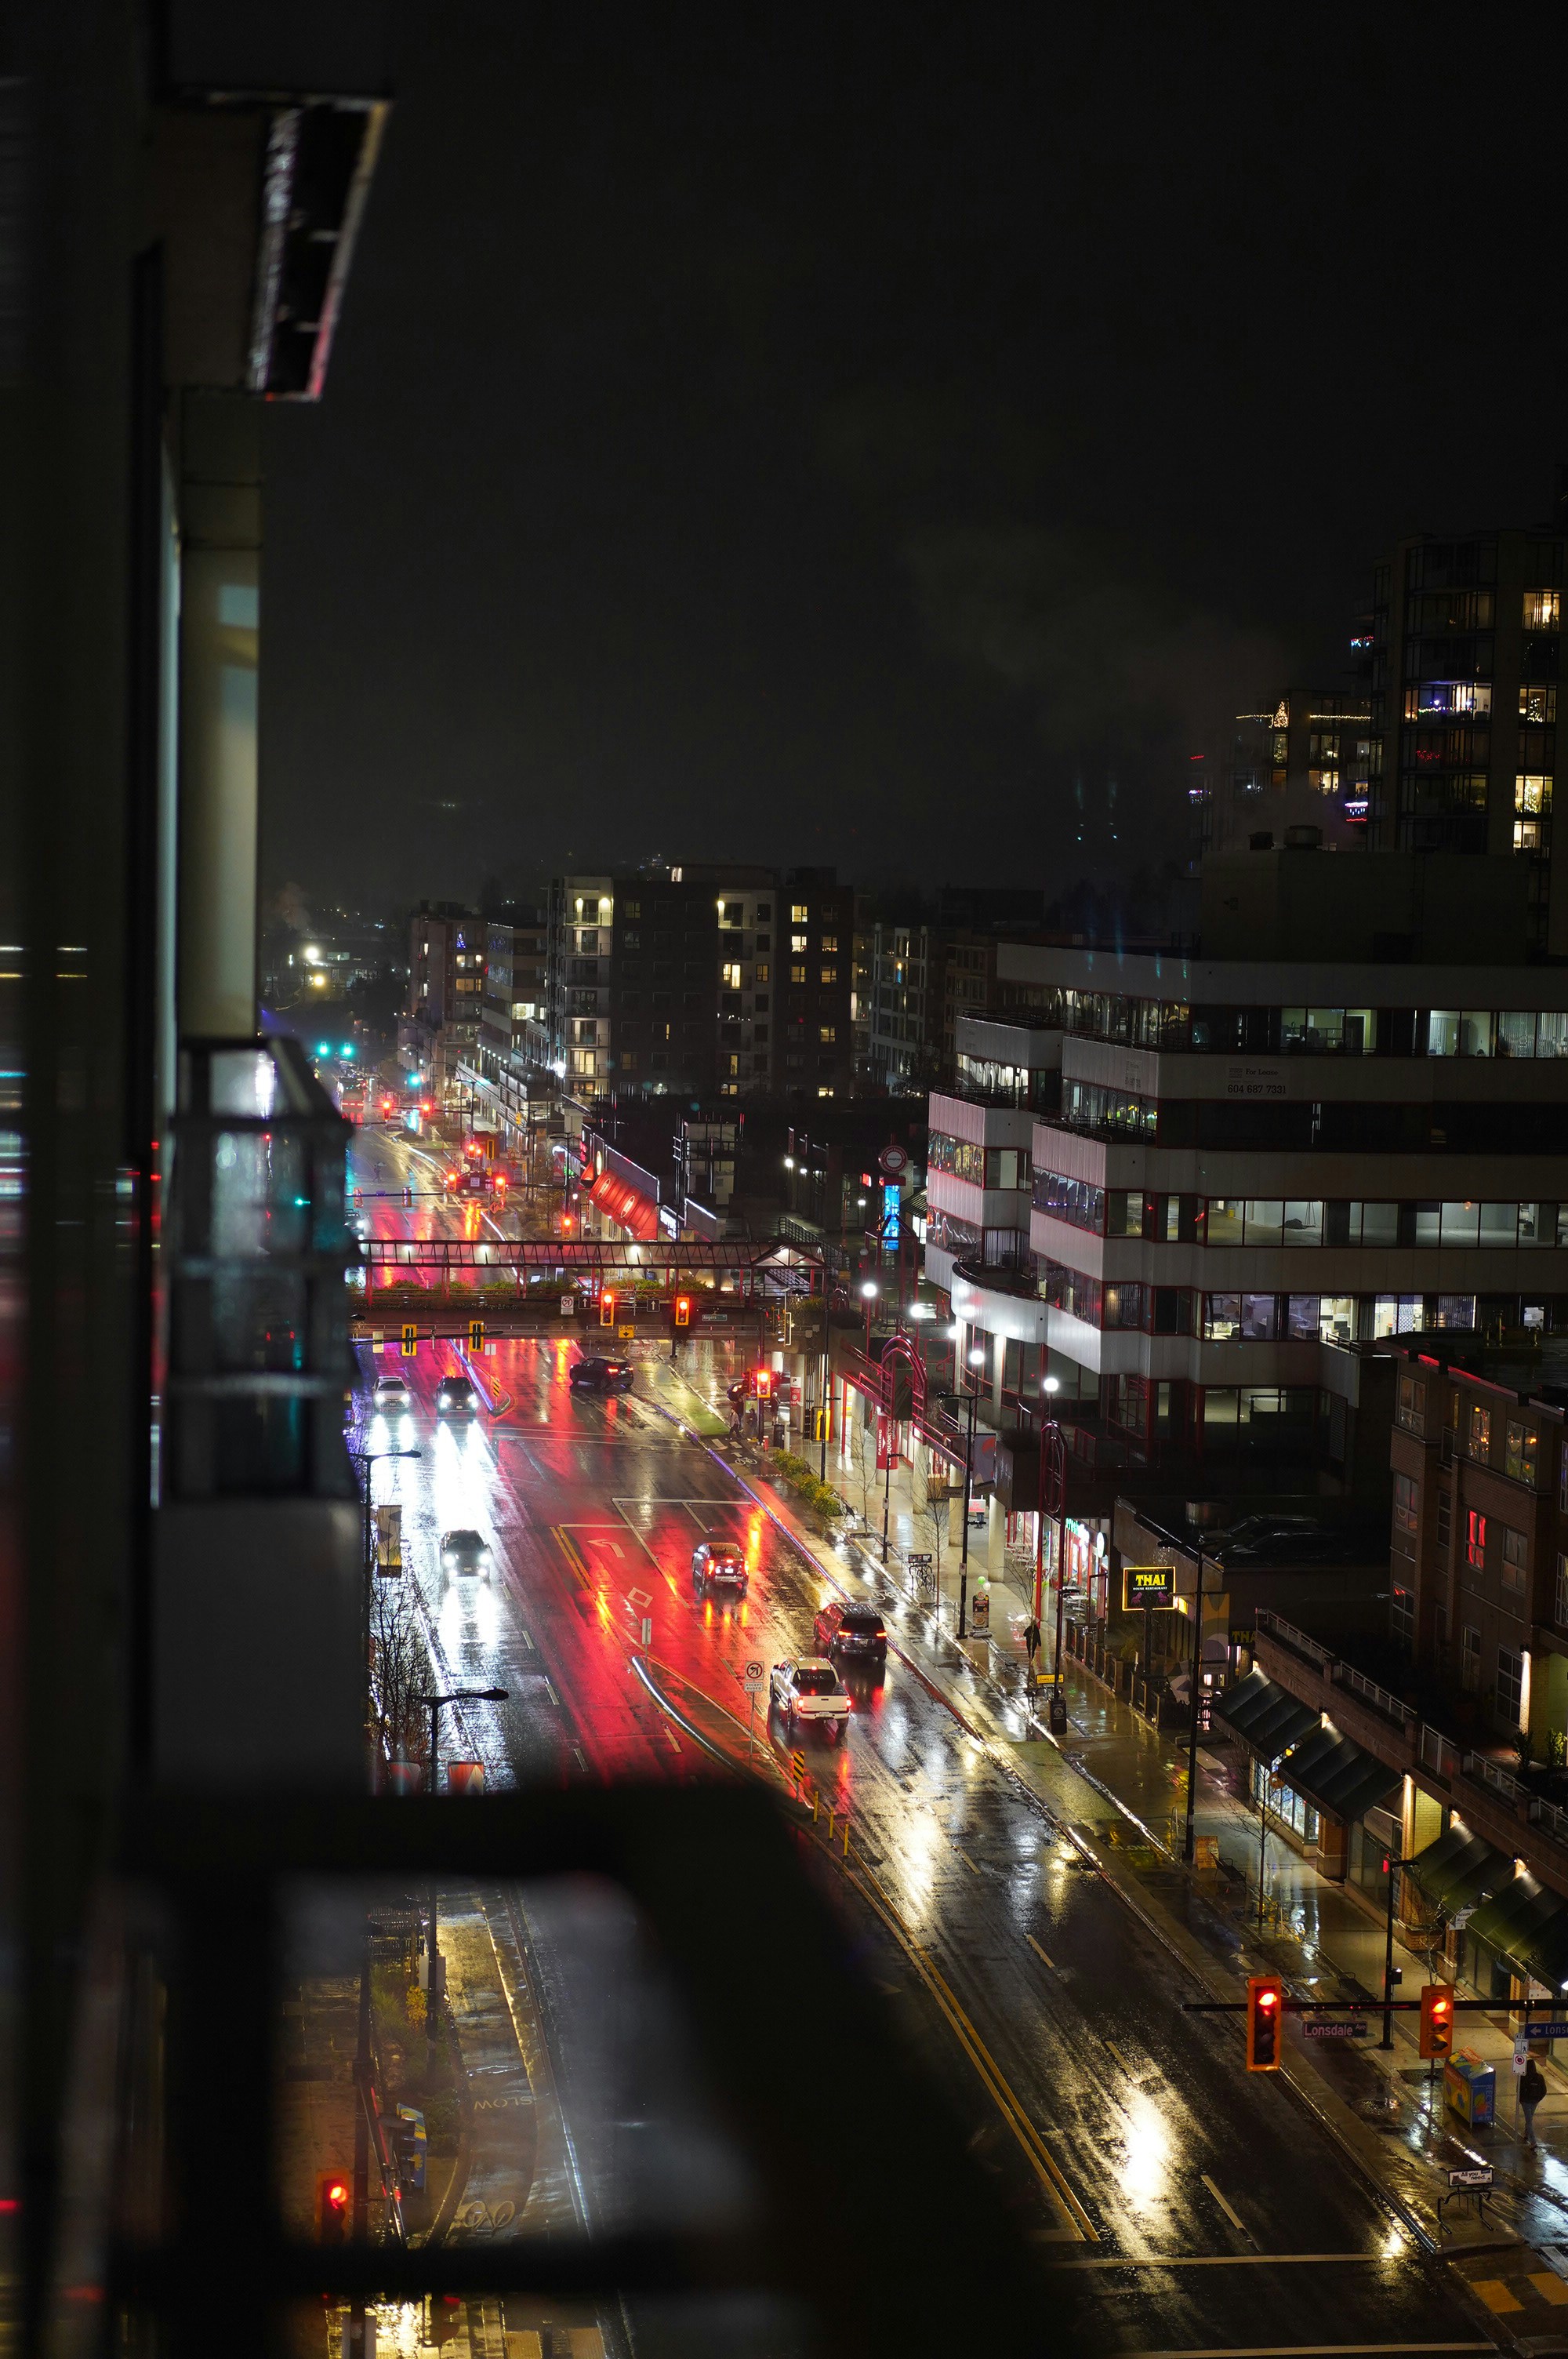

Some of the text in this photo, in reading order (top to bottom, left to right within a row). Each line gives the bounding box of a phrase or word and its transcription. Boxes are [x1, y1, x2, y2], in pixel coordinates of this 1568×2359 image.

[1228, 1085, 1286, 1094] 604 687 7331
[1135, 1574, 1166, 1586] THAI
[1231, 1630, 1255, 1643] THA
[1304, 2023, 1353, 2036] Lonsdale
[474, 2095, 533, 2110] SLOW
[1485, 2085, 1494, 2121] RECYCLE
